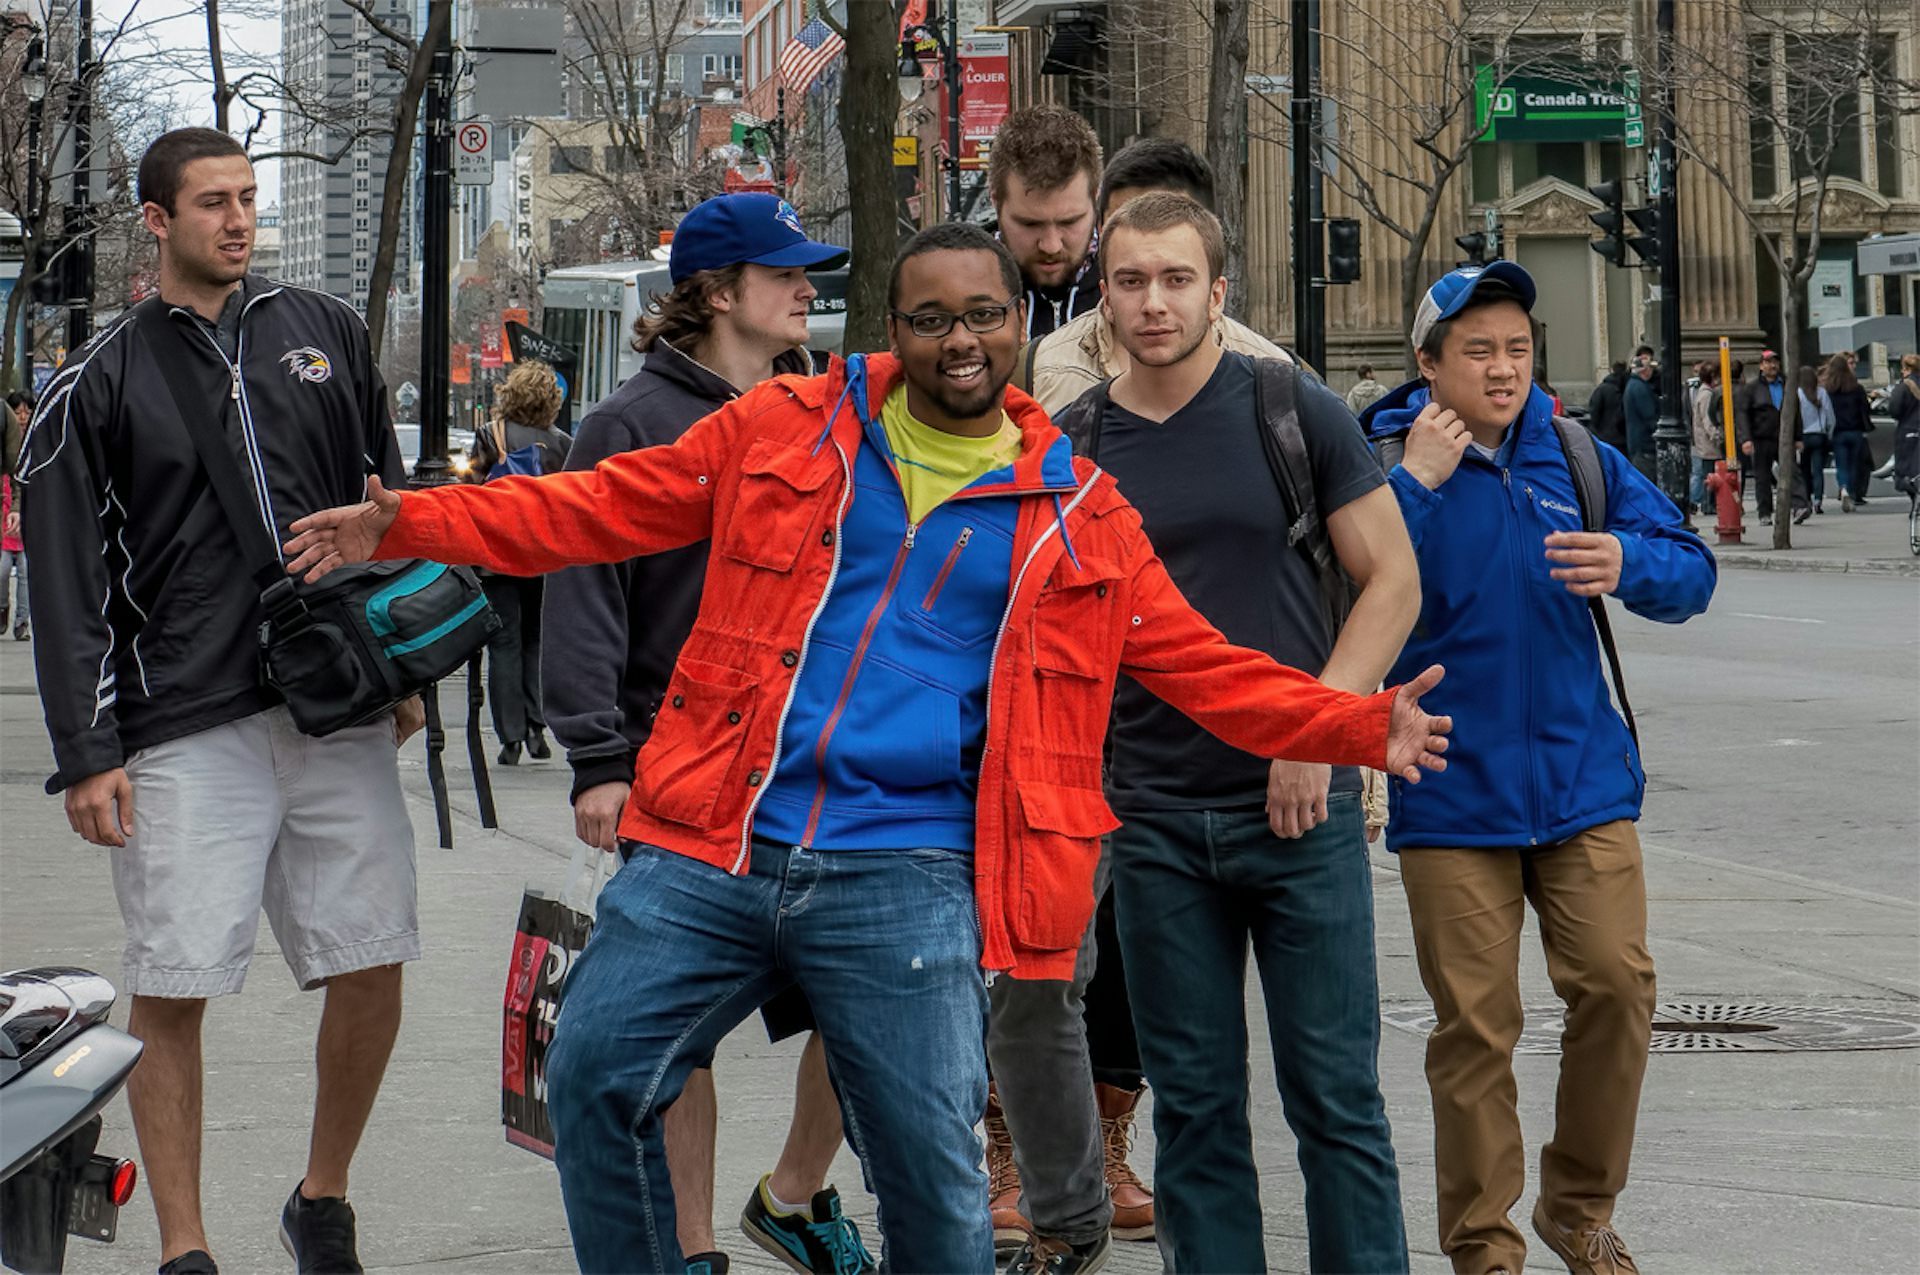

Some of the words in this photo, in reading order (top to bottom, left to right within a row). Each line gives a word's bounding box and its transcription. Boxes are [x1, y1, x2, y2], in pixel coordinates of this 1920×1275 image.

[966, 73, 1006, 84] LOUER
[1487, 93, 1513, 112] TD
[1523, 92, 1587, 106] Canada
[1589, 93, 1627, 106] Tru
